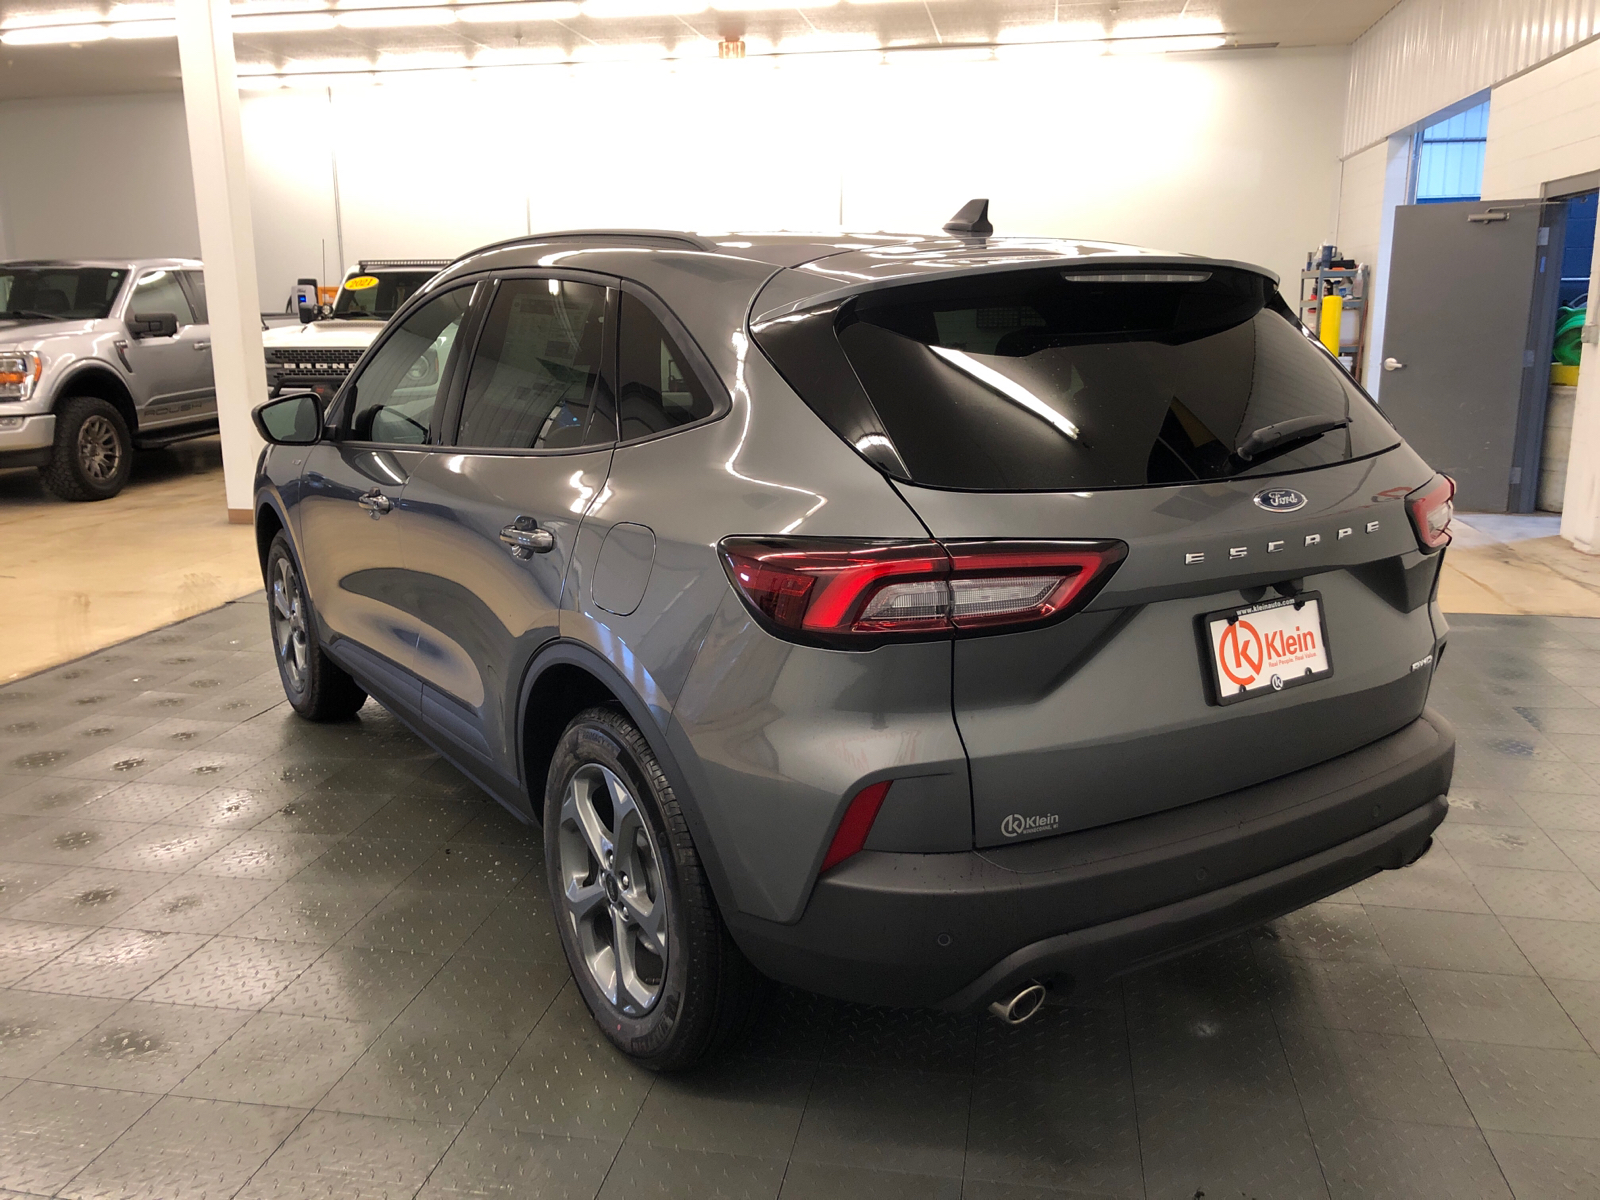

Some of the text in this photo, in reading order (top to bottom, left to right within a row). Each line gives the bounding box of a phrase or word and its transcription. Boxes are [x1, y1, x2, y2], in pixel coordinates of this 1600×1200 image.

[349, 278, 374, 289] 2021
[144, 401, 203, 416] ROUSH
[1268, 491, 1298, 506] Ford
[1185, 520, 1380, 565] ESCAPE
[1236, 598, 1295, 616] www.kleinauto.com
[1264, 626, 1316, 660] Klein
[1026, 813, 1059, 829] Klein
